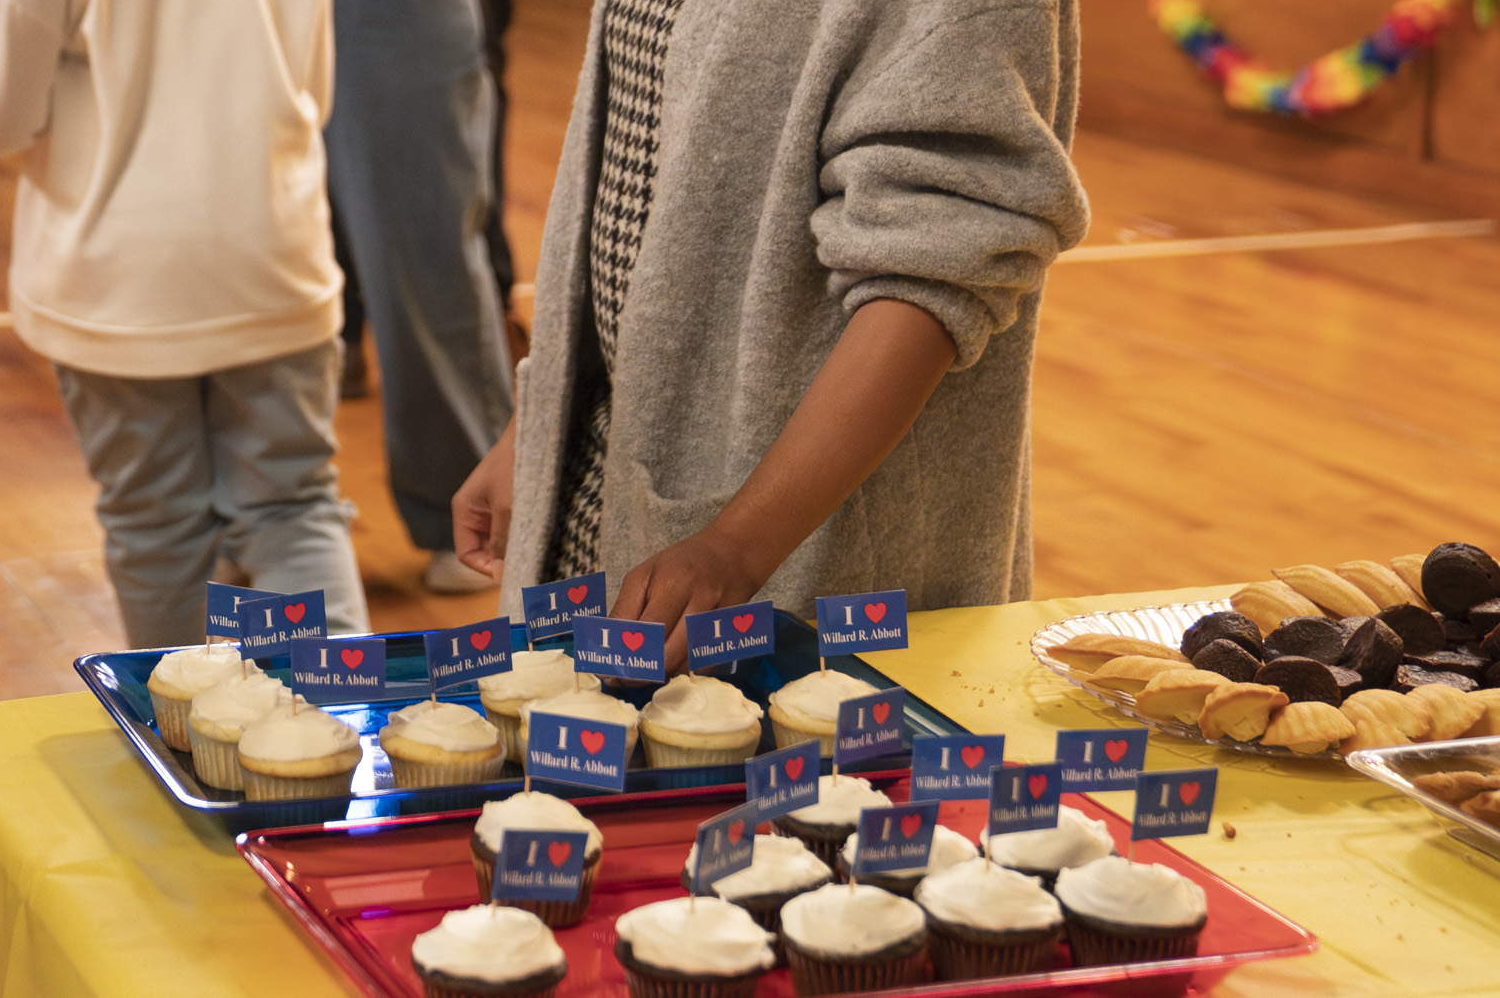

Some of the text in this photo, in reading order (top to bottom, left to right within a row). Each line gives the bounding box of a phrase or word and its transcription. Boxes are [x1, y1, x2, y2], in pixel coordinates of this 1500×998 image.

[549, 592, 557, 610] I
[264, 608, 273, 628] I
[529, 613, 560, 630] Willard
[561, 611, 571, 623] R.
[844, 605, 854, 626] I
[243, 625, 321, 649] Willard R. Abbott
[600, 628, 610, 648] I
[713, 619, 722, 638] I
[822, 627, 901, 645] Willard R. Abbott
[450, 636, 460, 657] I
[691, 634, 768, 659] Willard R. Abbott
[319, 648, 328, 668] I
[432, 651, 506, 679] Willard R. Abbott
[577, 650, 658, 670] Willard R. Abbott
[294, 672, 378, 686] Willard R. Abbott
[857, 707, 864, 730] I
[557, 725, 568, 751] I
[940, 747, 950, 771] I
[1084, 741, 1093, 763] I
[530, 750, 618, 778] Willard R. Abbott
[769, 763, 777, 789] I
[915, 775, 949, 789] Willard
[951, 774, 961, 787] R.
[1011, 776, 1020, 801] I
[1159, 783, 1170, 808] I
[881, 817, 892, 842] I
[527, 840, 539, 867] I
